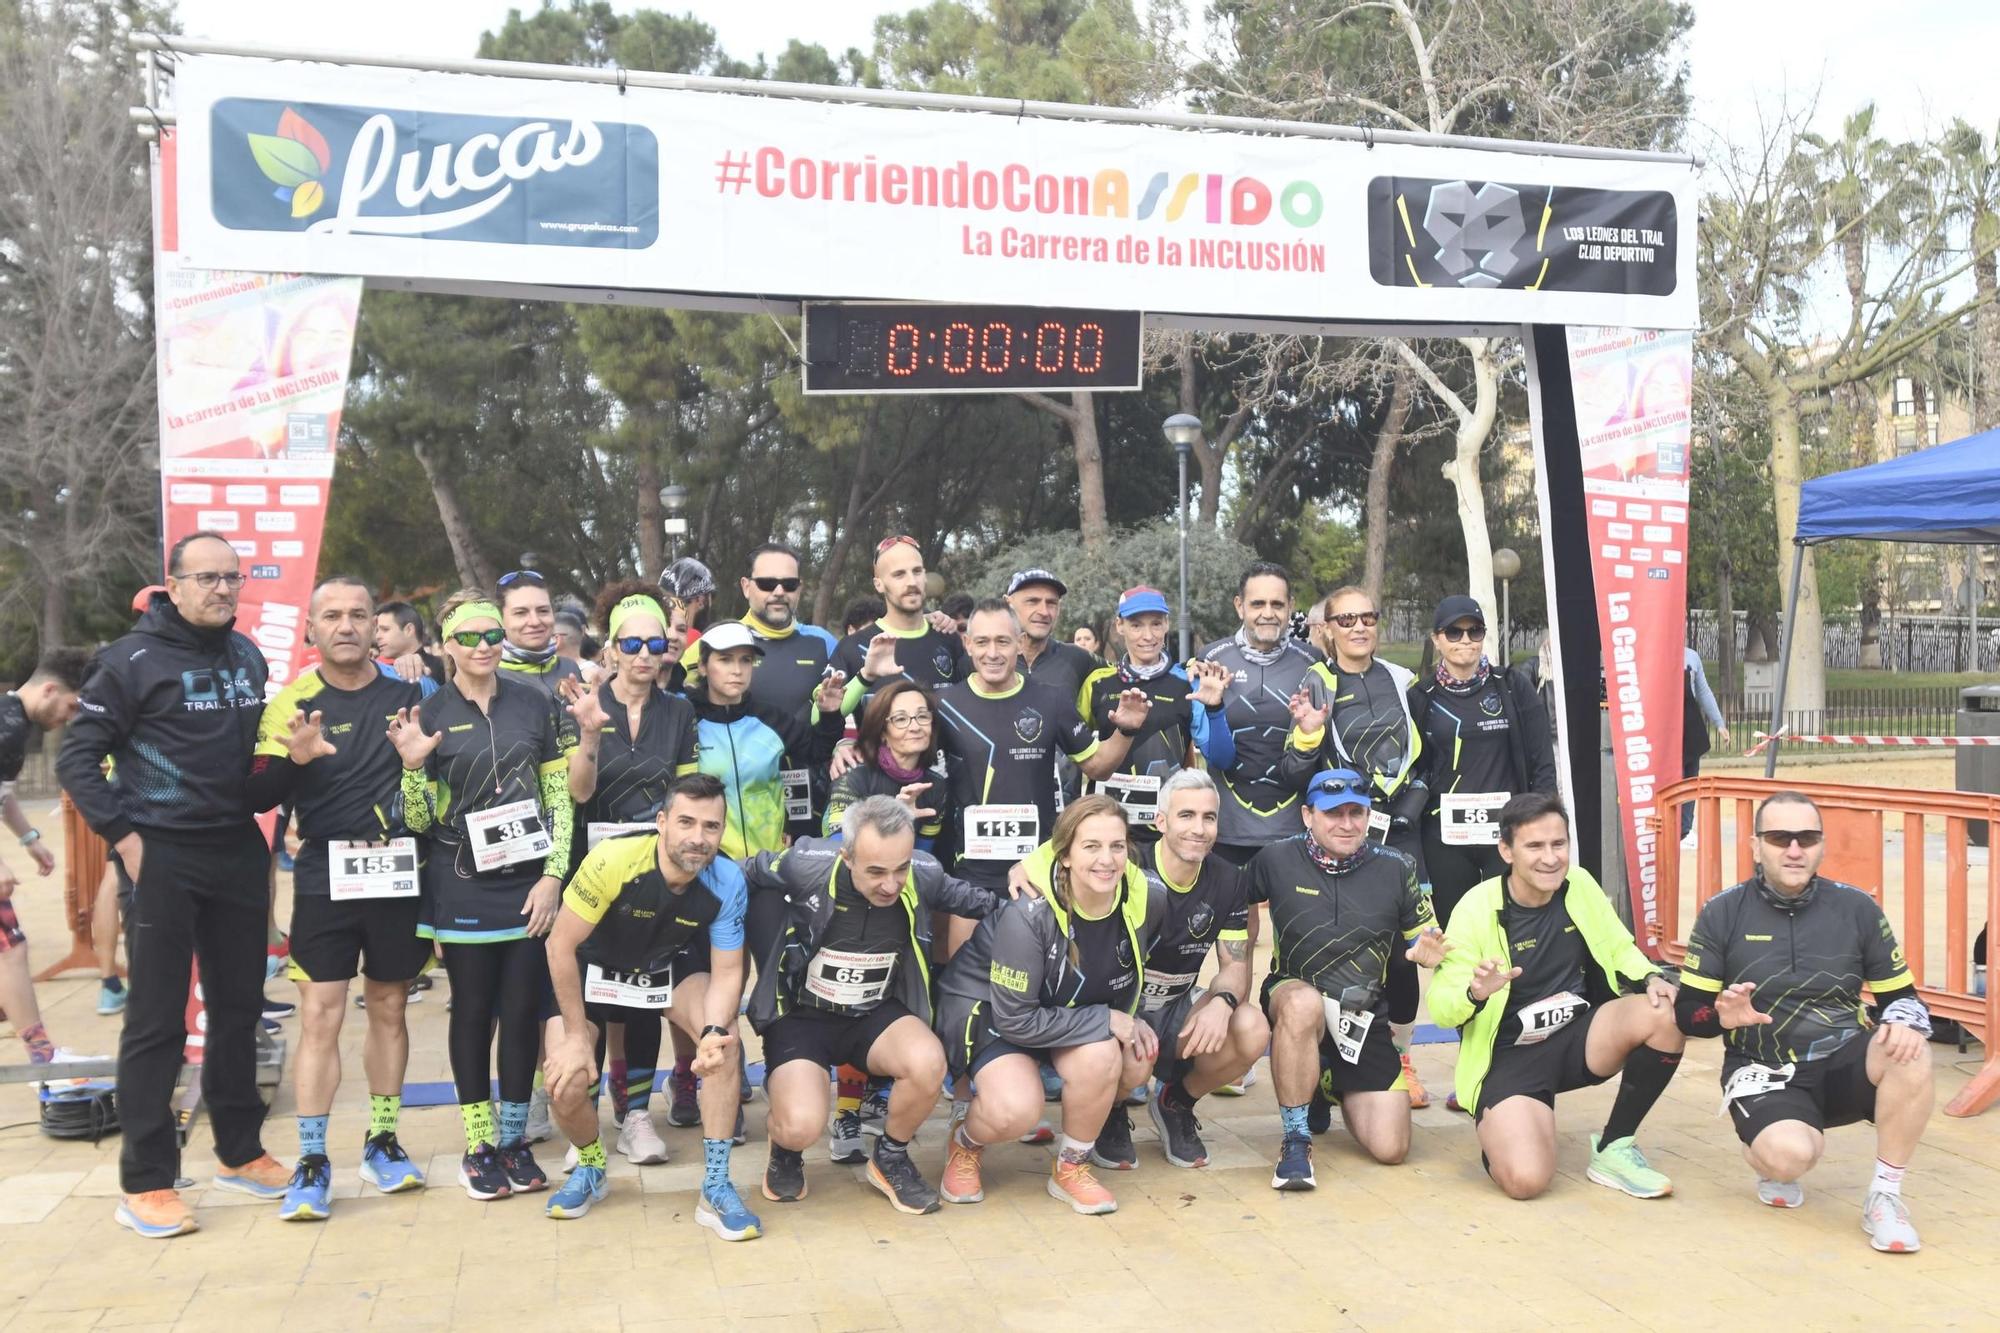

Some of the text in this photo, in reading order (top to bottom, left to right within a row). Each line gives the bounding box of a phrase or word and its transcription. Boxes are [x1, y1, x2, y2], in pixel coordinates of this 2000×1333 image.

[306, 113, 602, 235] Lucas
[714, 146, 1324, 228] #CorriendoConASSIDO
[540, 221, 638, 233] www.grupolucas.com
[1563, 226, 1665, 247] LOS LEONES DEL TRAIL
[962, 225, 1326, 273] La Carrera de la INCLUSIÓN
[1578, 244, 1655, 263] CLUB DEPORTIVO
[887, 322, 1105, 376] 0:00:00
[167, 415, 184, 430] La
[186, 399, 237, 424] carrera
[239, 393, 255, 409] de
[257, 389, 271, 405] la
[1581, 438, 1590, 448] La
[1591, 428, 1622, 446] carrera
[1623, 425, 1633, 437] de
[1634, 423, 1643, 434] la
[1608, 592, 1632, 623] La
[1611, 627, 1646, 732] Carrera
[1625, 735, 1653, 772] de
[1630, 774, 1656, 803] la
[1464, 808, 1489, 824] 56
[498, 820, 525, 841] 38
[983, 821, 1020, 837] 113
[352, 855, 396, 875] 155
[836, 967, 865, 984] 65
[1144, 983, 1171, 996] 85
[1541, 1006, 1574, 1027] 105
[472, 1120, 489, 1130] RUN
